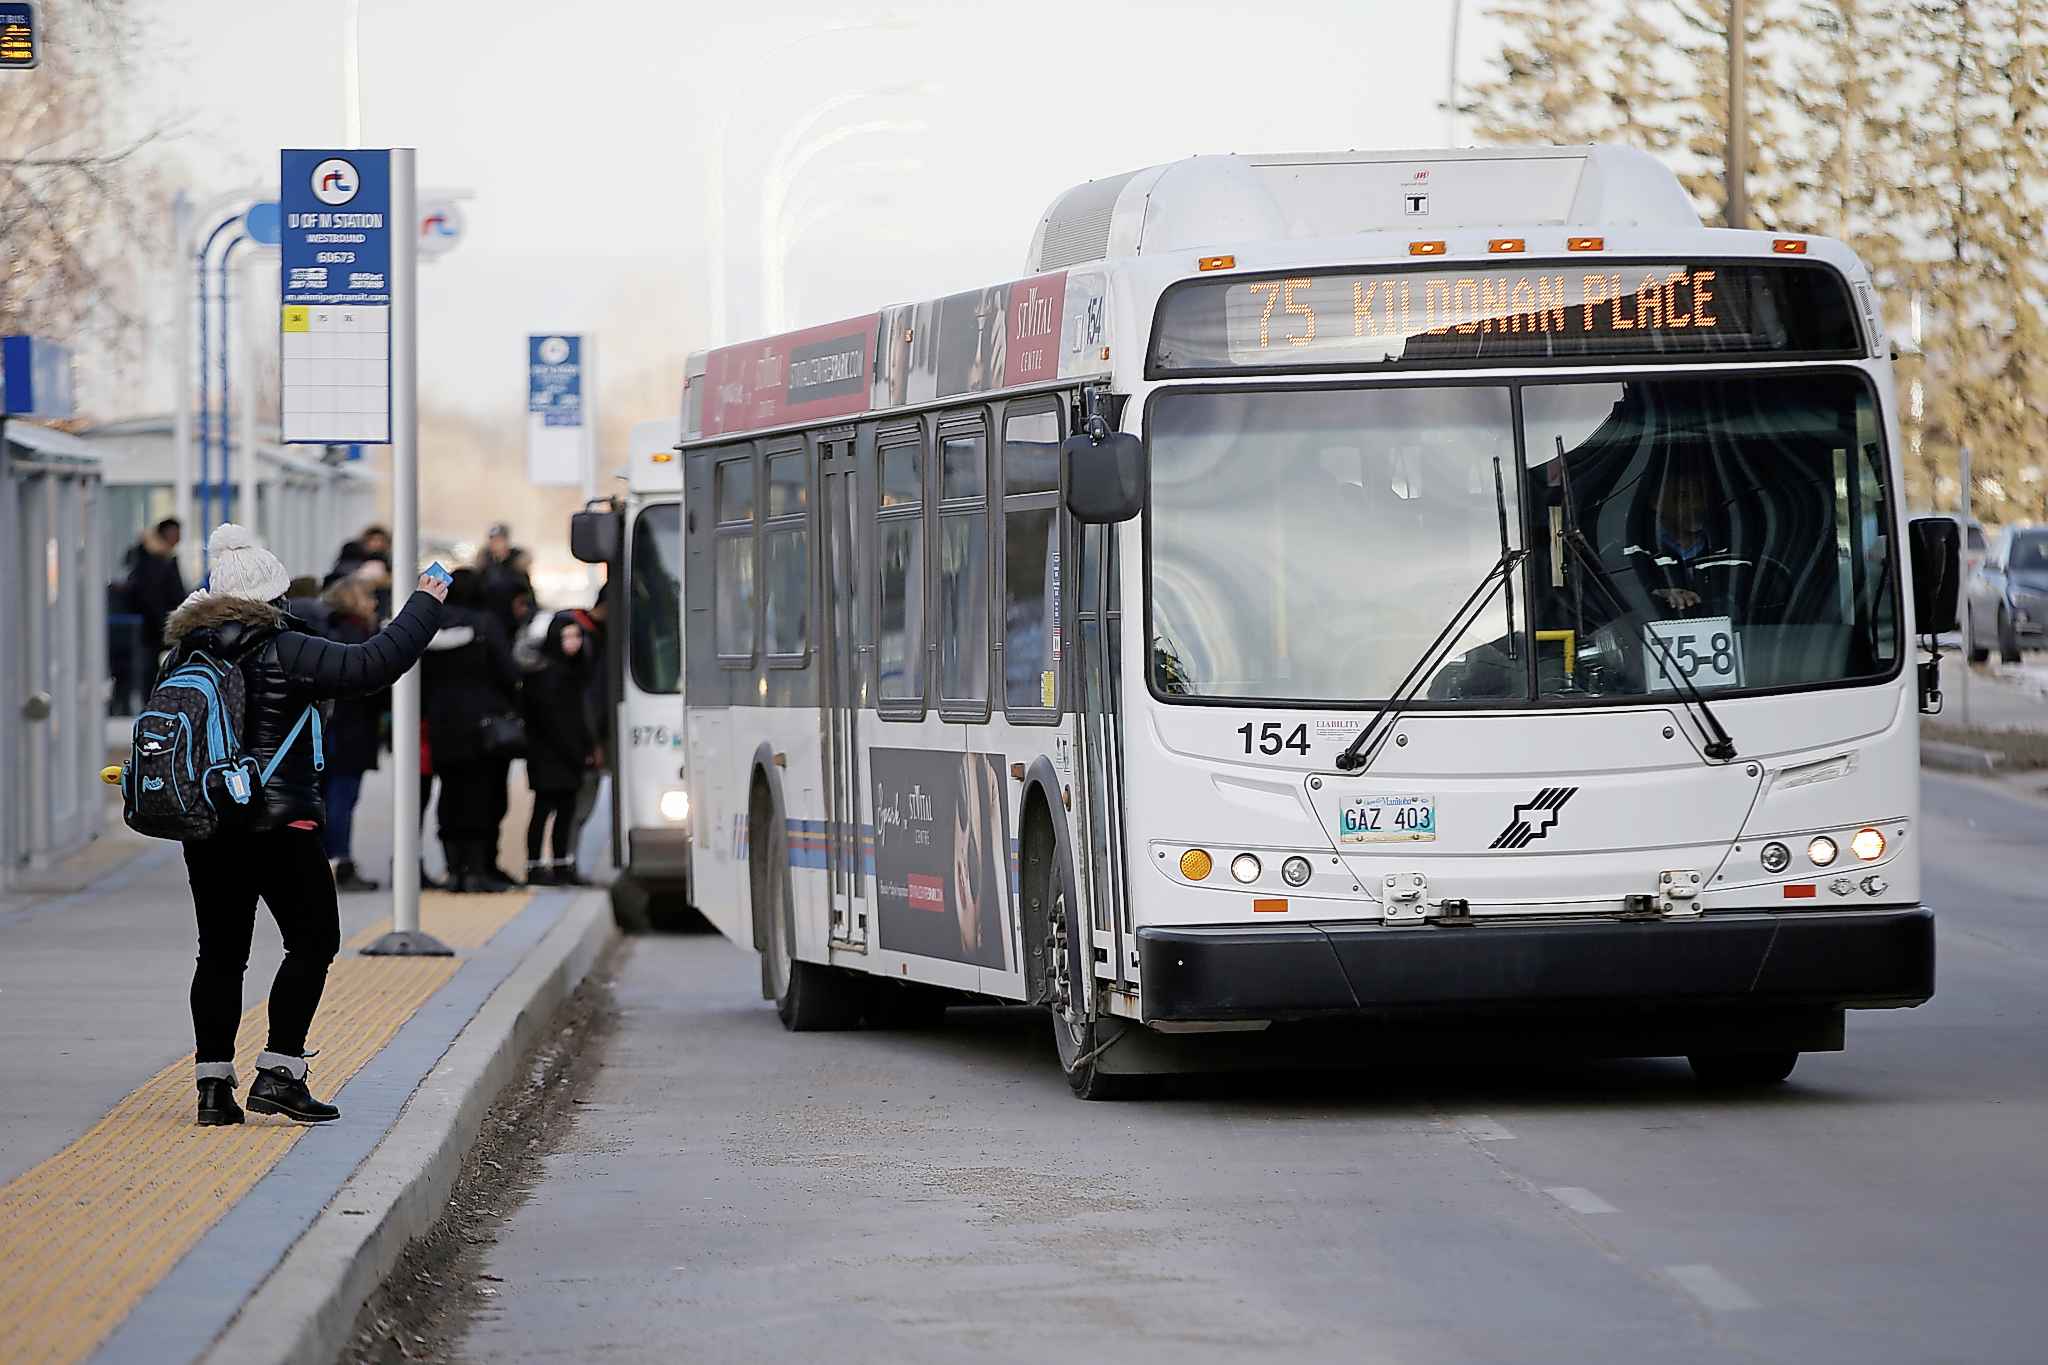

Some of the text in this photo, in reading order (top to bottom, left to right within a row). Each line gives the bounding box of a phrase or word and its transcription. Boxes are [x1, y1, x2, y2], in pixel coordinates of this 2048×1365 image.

[288, 213, 383, 229] U OF M STATION
[306, 234, 366, 243] WESTBOUND
[1248, 270, 1718, 349] 75 KILDONAN PLACE
[1020, 350, 1043, 373] CENTRE
[1651, 632, 1736, 679] 75-8
[1316, 720, 1360, 728] LIABILITY
[1237, 722, 1311, 756] 154
[1345, 807, 1431, 831] GAZ 403
